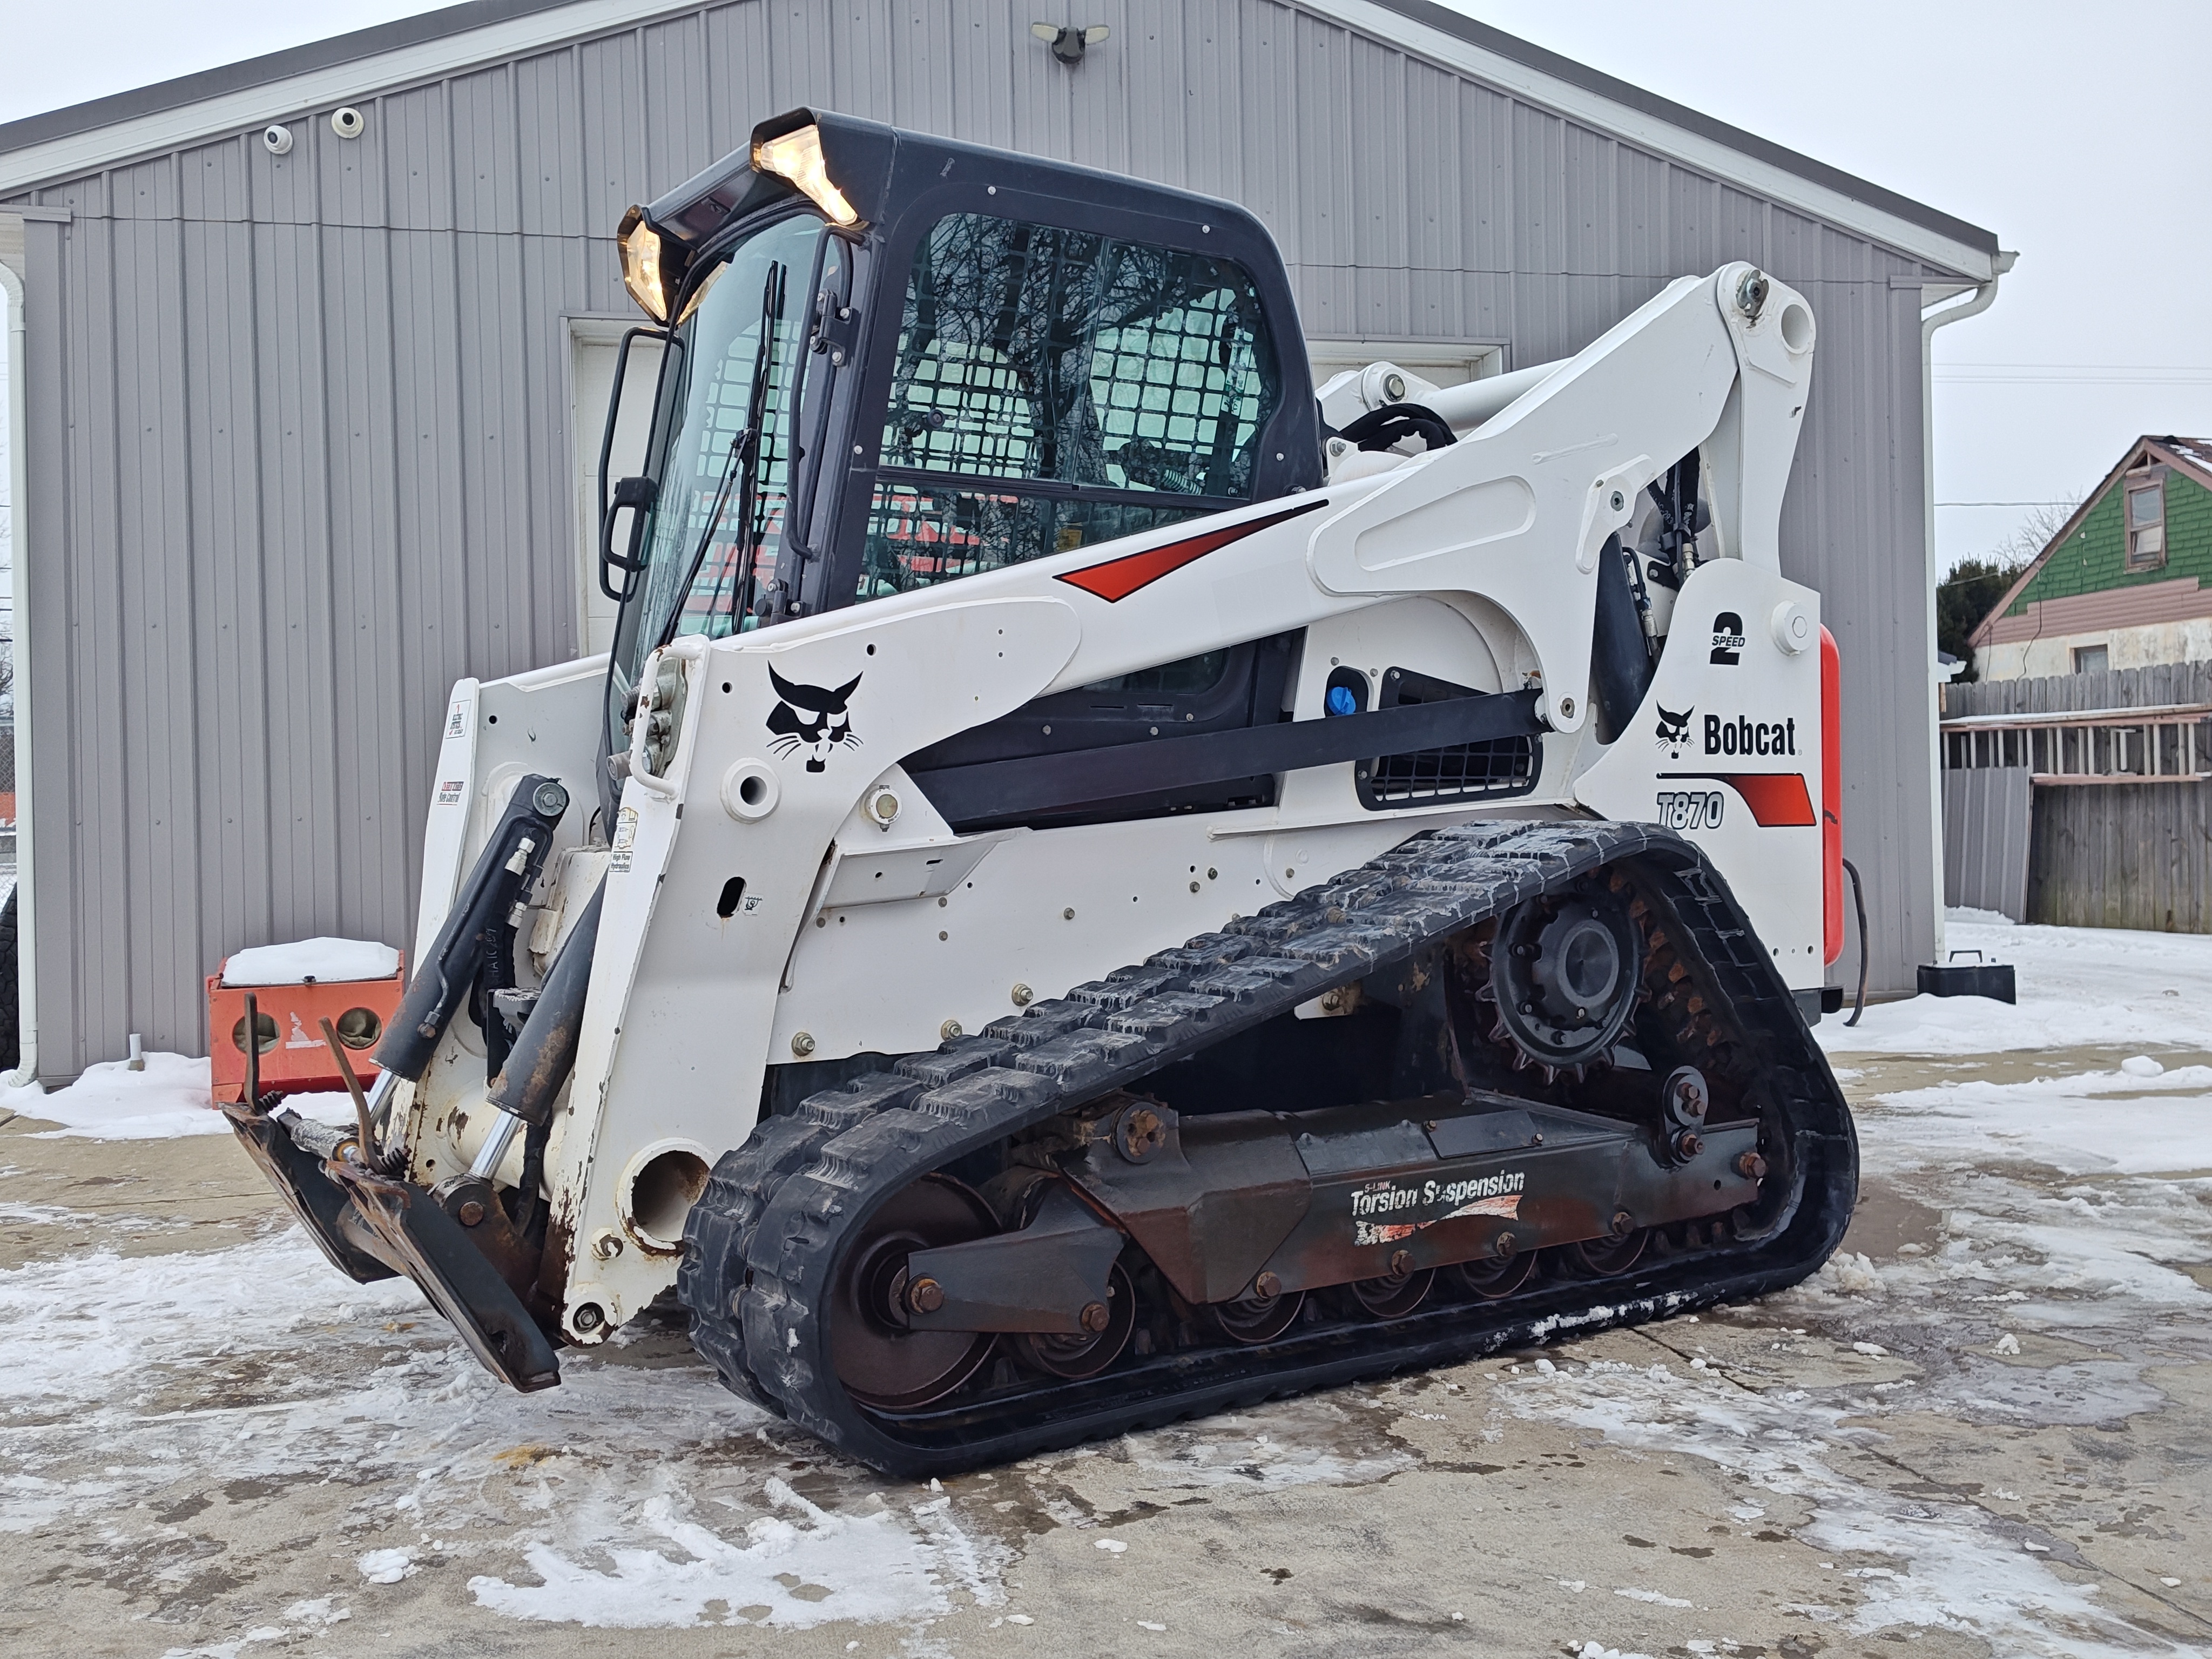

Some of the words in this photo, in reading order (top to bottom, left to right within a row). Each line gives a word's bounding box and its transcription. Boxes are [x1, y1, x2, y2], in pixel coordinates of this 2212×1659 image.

[1709, 611, 1743, 666] 2
[1711, 635, 1745, 648] SPEED
[1704, 714, 1796, 756] Bobcat
[1657, 791, 1724, 830] T870
[1351, 1185, 1418, 1216] Torsion
